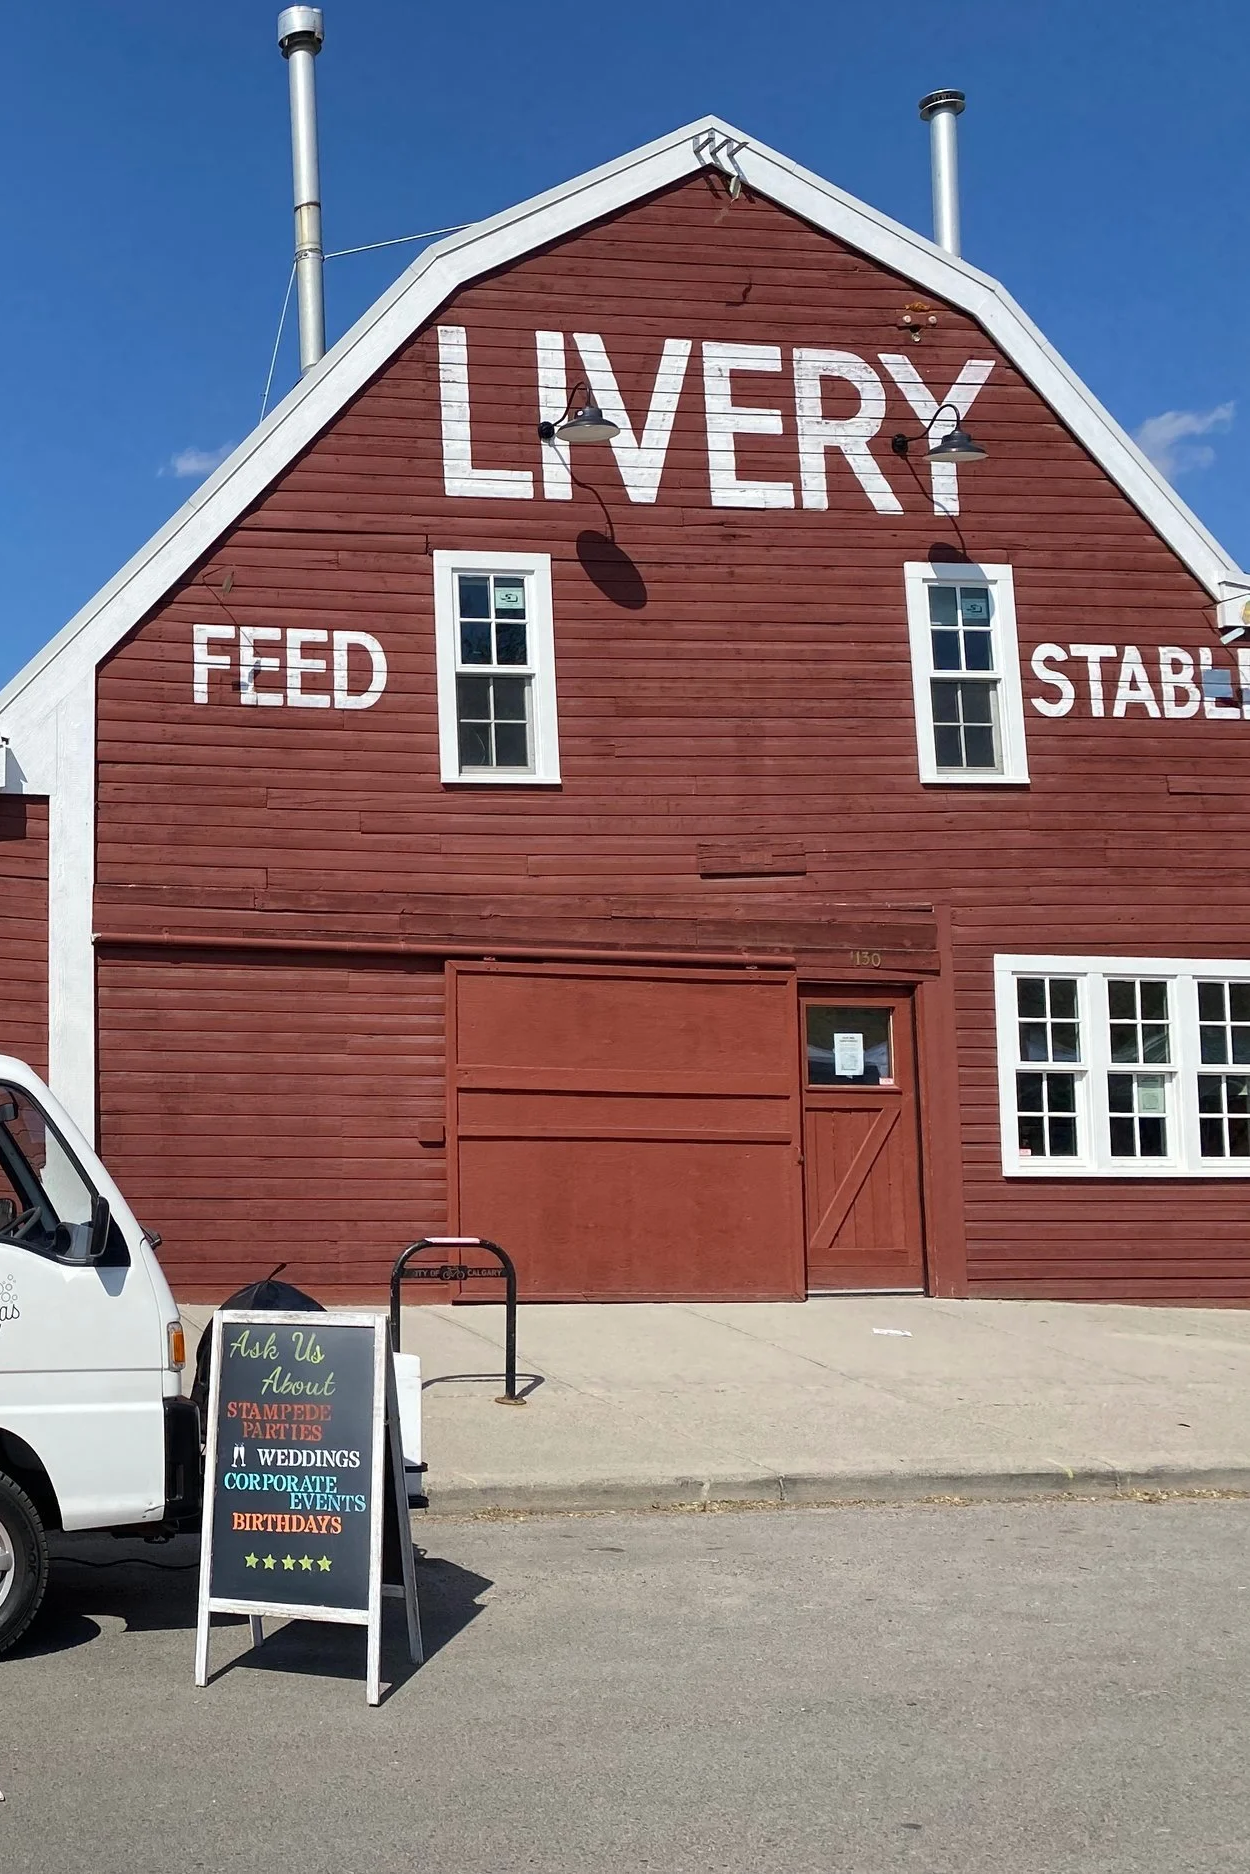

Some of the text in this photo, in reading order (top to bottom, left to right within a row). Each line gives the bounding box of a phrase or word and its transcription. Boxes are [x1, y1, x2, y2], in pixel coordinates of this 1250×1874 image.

[436, 325, 996, 517] LIVERY
[192, 623, 388, 710] FEED
[467, 1269, 503, 1277] CALGARY
[229, 1329, 325, 1364] Ask Us
[261, 1366, 336, 1396] About
[227, 1401, 332, 1421] STAMPEDE
[242, 1421, 323, 1442] PARTIES
[257, 1448, 361, 1469] WEDDINGS
[224, 1472, 338, 1494] CORPORATE
[289, 1493, 367, 1512] EVENTS
[232, 1512, 343, 1535] BIRTHDAYS
